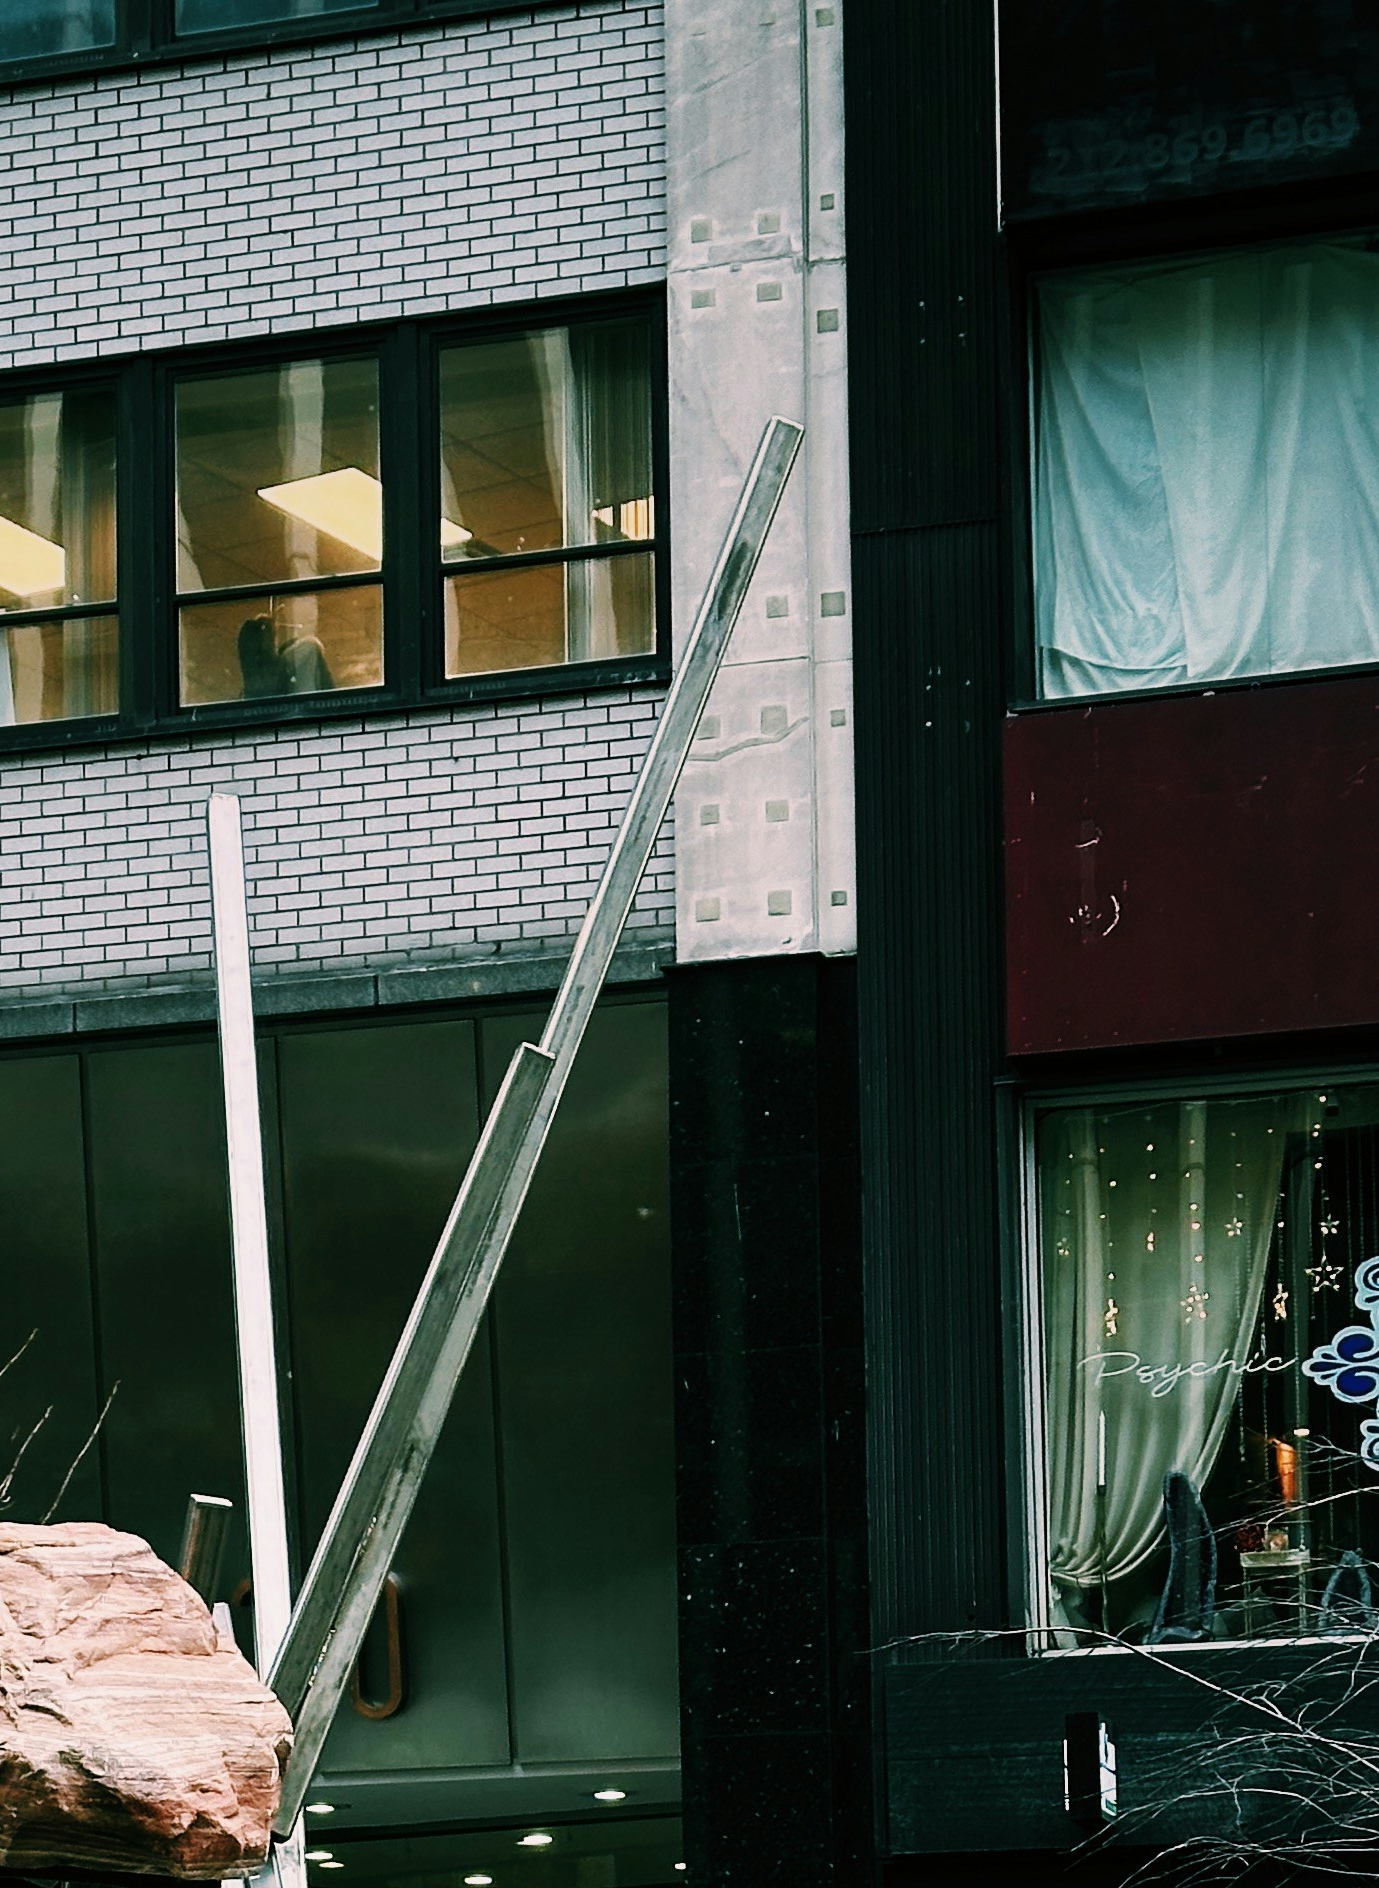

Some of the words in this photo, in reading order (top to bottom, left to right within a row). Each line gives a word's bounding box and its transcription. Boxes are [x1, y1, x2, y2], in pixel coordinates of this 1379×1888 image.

[1143, 124, 1229, 170] 869
[1242, 105, 1360, 154] 6969
[1076, 1348, 1297, 1398] Psychic
